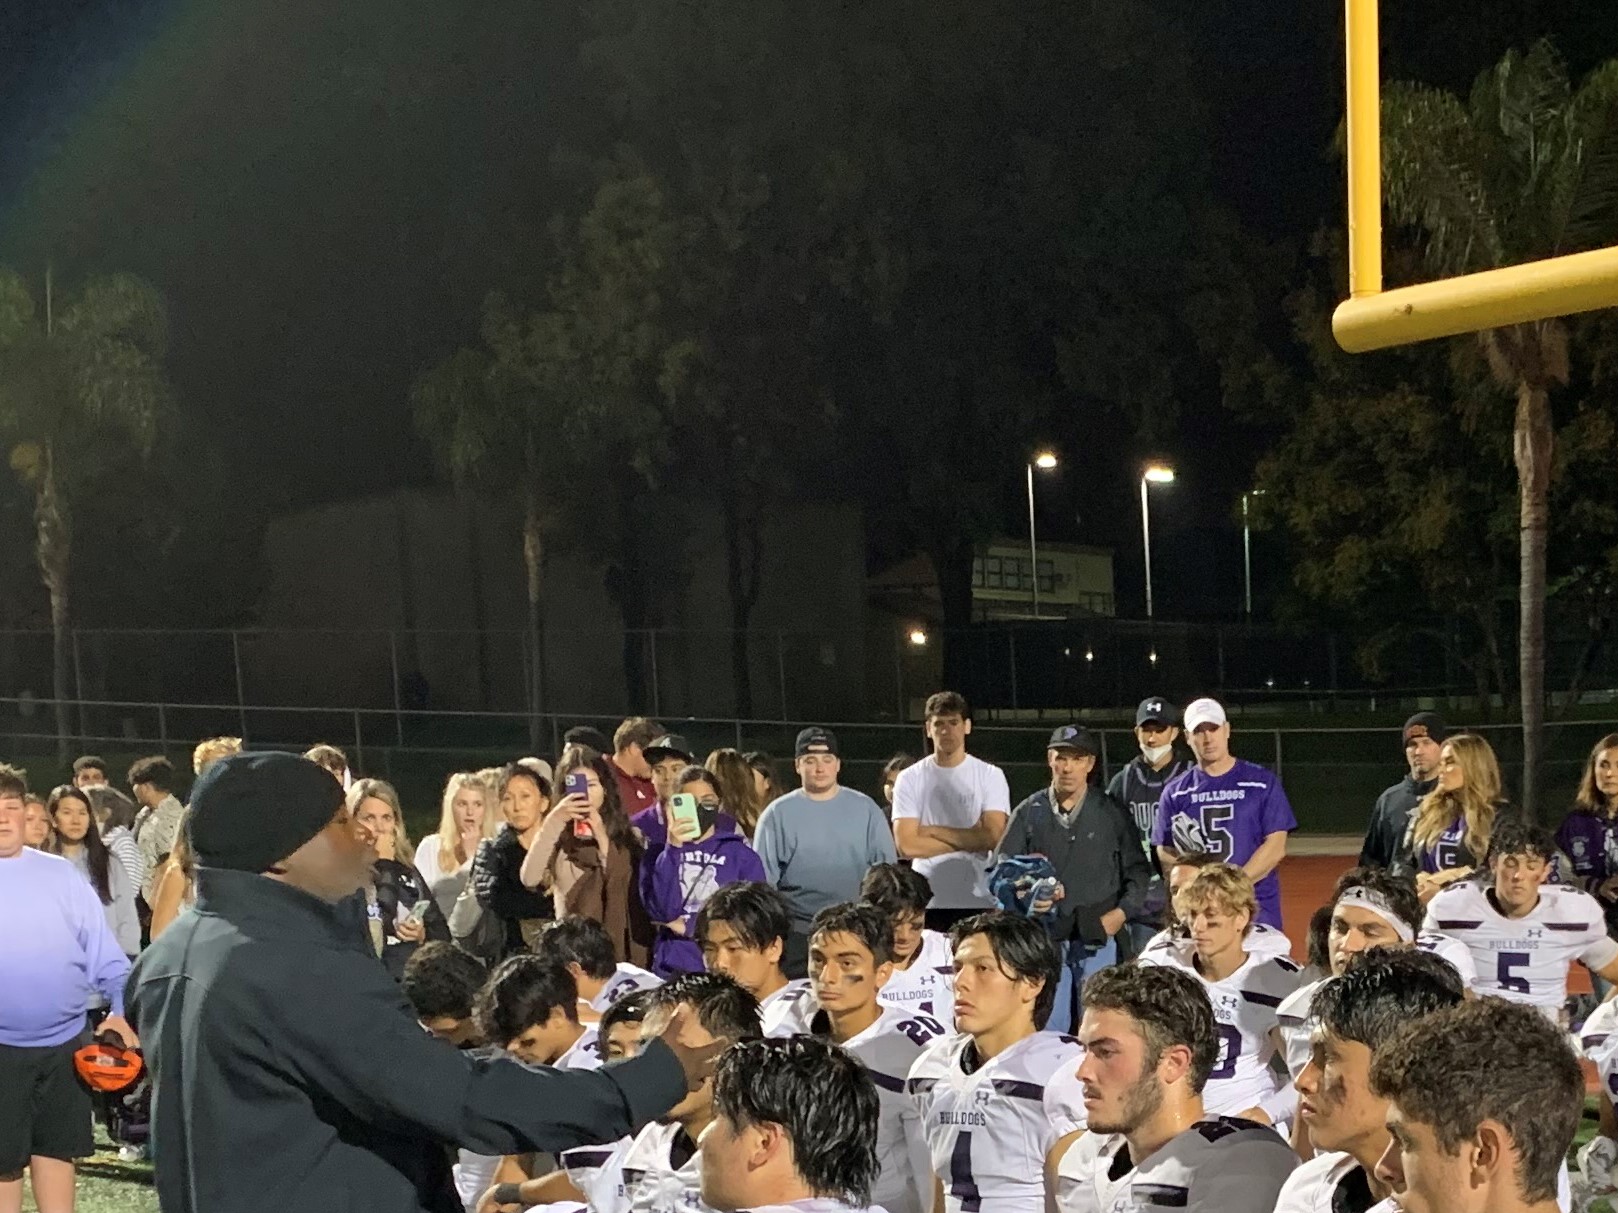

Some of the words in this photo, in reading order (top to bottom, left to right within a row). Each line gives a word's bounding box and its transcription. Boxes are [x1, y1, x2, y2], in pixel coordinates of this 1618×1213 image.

[1191, 790, 1245, 803] BULLDOGS
[1489, 939, 1540, 951] BULLDOGS
[1497, 952, 1531, 994] 5
[896, 1015, 946, 1047] 20
